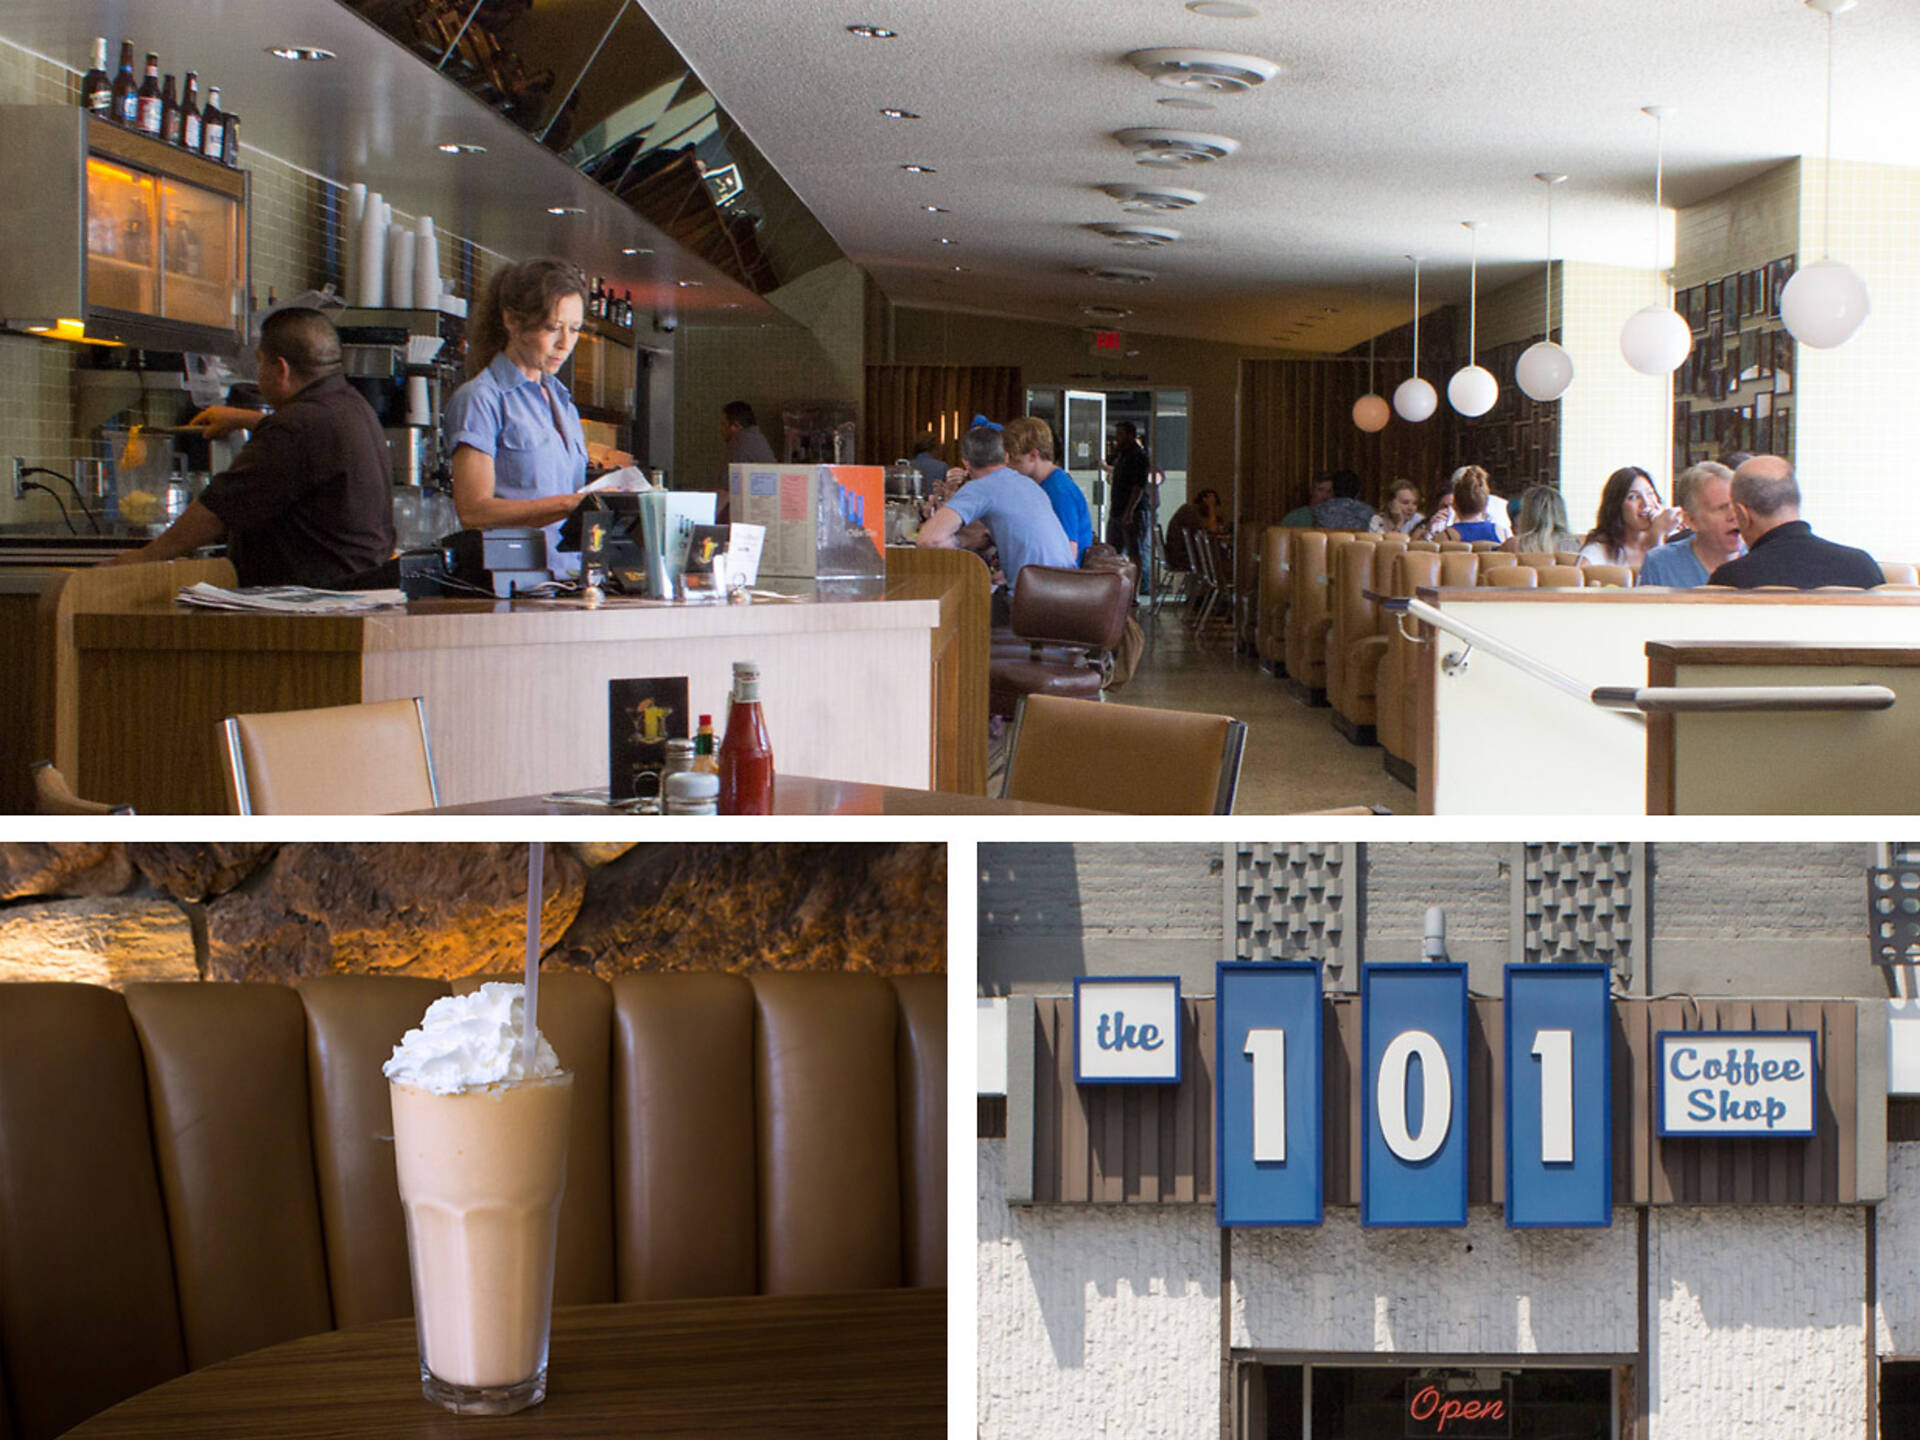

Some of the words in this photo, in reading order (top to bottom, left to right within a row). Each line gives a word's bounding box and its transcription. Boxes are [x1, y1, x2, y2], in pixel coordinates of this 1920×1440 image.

[1096, 1011, 1164, 1051] the
[1670, 1048, 1805, 1085] Coffee
[1687, 1088, 1787, 1129] Shop
[1410, 1384, 1506, 1433] Open
